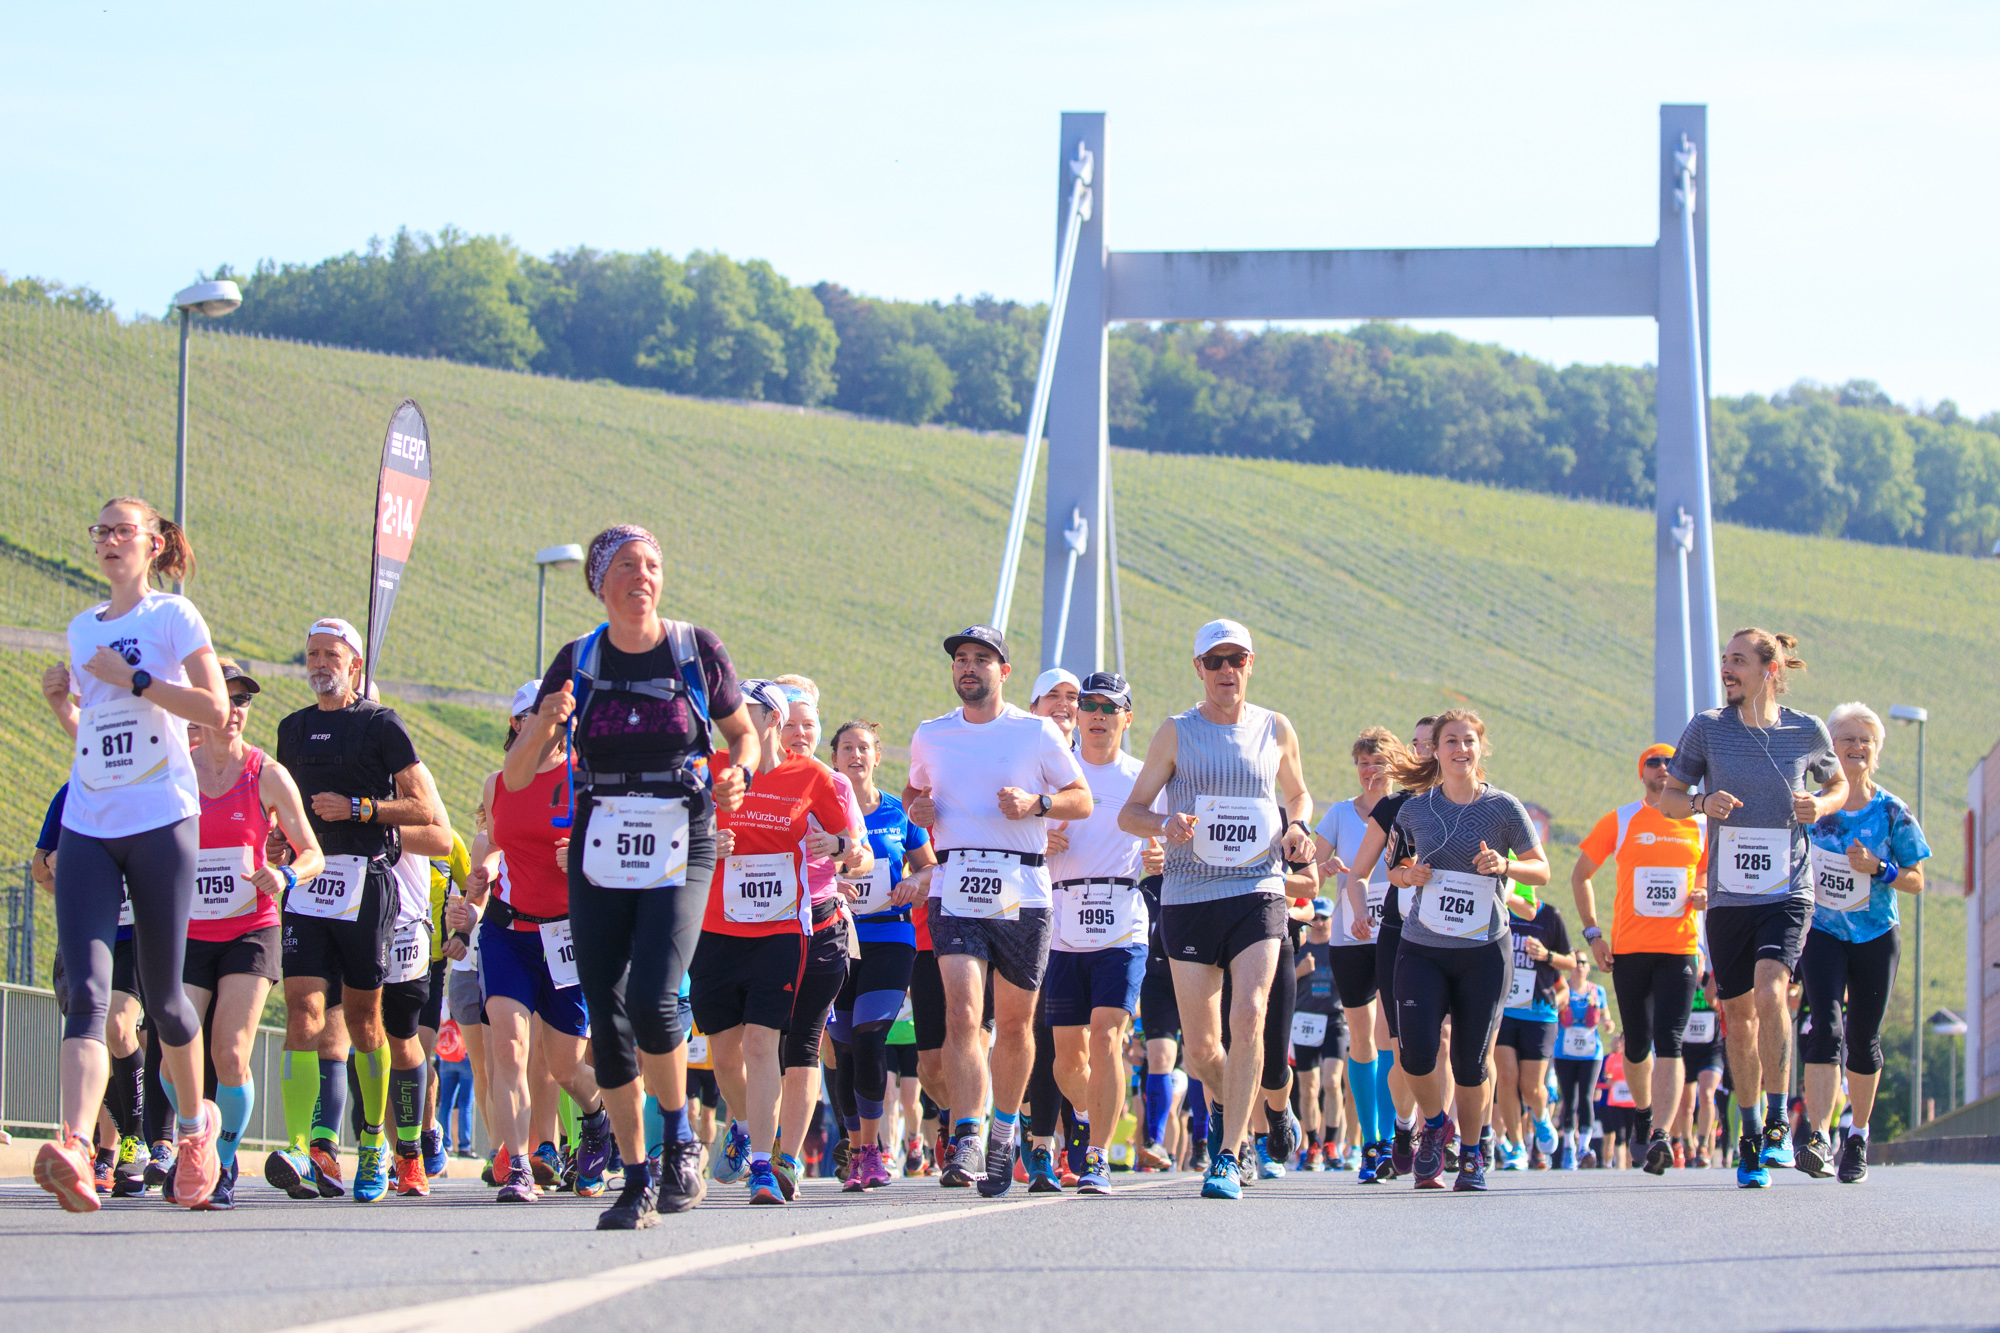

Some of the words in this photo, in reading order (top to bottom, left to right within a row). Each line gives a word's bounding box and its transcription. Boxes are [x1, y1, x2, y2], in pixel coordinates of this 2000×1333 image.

[402, 435, 426, 470] cep
[382, 492, 414, 540] 2:14
[102, 731, 133, 757] 817
[316, 733, 331, 741] cep
[105, 758, 133, 769] Jessica
[757, 792, 780, 800] marathon
[623, 820, 652, 828] Marathon
[746, 810, 791, 826] Würzburg
[756, 822, 774, 830] wieder
[867, 827, 888, 835] WERK
[1207, 823, 1257, 843] 10204
[617, 833, 656, 856] 510
[1223, 844, 1241, 852] Horst
[620, 859, 650, 869] Bettina
[1733, 853, 1771, 871] 1285
[1824, 864, 1851, 874] Halbmarathon
[323, 869, 344, 877] marathon
[1744, 872, 1760, 880] Hans
[195, 874, 235, 895] 1759
[307, 877, 346, 898] 2073
[959, 875, 1002, 895] 2329
[1820, 871, 1855, 892] 2554
[739, 880, 783, 899] 10174
[1443, 886, 1474, 896] Halbmarathon
[1646, 886, 1677, 900] 2353
[203, 897, 229, 905] Martina
[315, 897, 334, 906] Harald
[753, 900, 770, 908] Tanja
[967, 895, 993, 904] Mathias
[1438, 895, 1475, 916] 1264
[1077, 908, 1115, 925] 1995
[1367, 904, 1385, 918] 79
[1444, 914, 1464, 924] Leonie
[394, 944, 419, 962] 1173
[557, 944, 576, 964] 10
[1513, 951, 1535, 969] RG
[132, 1067, 145, 1117] Kalenji
